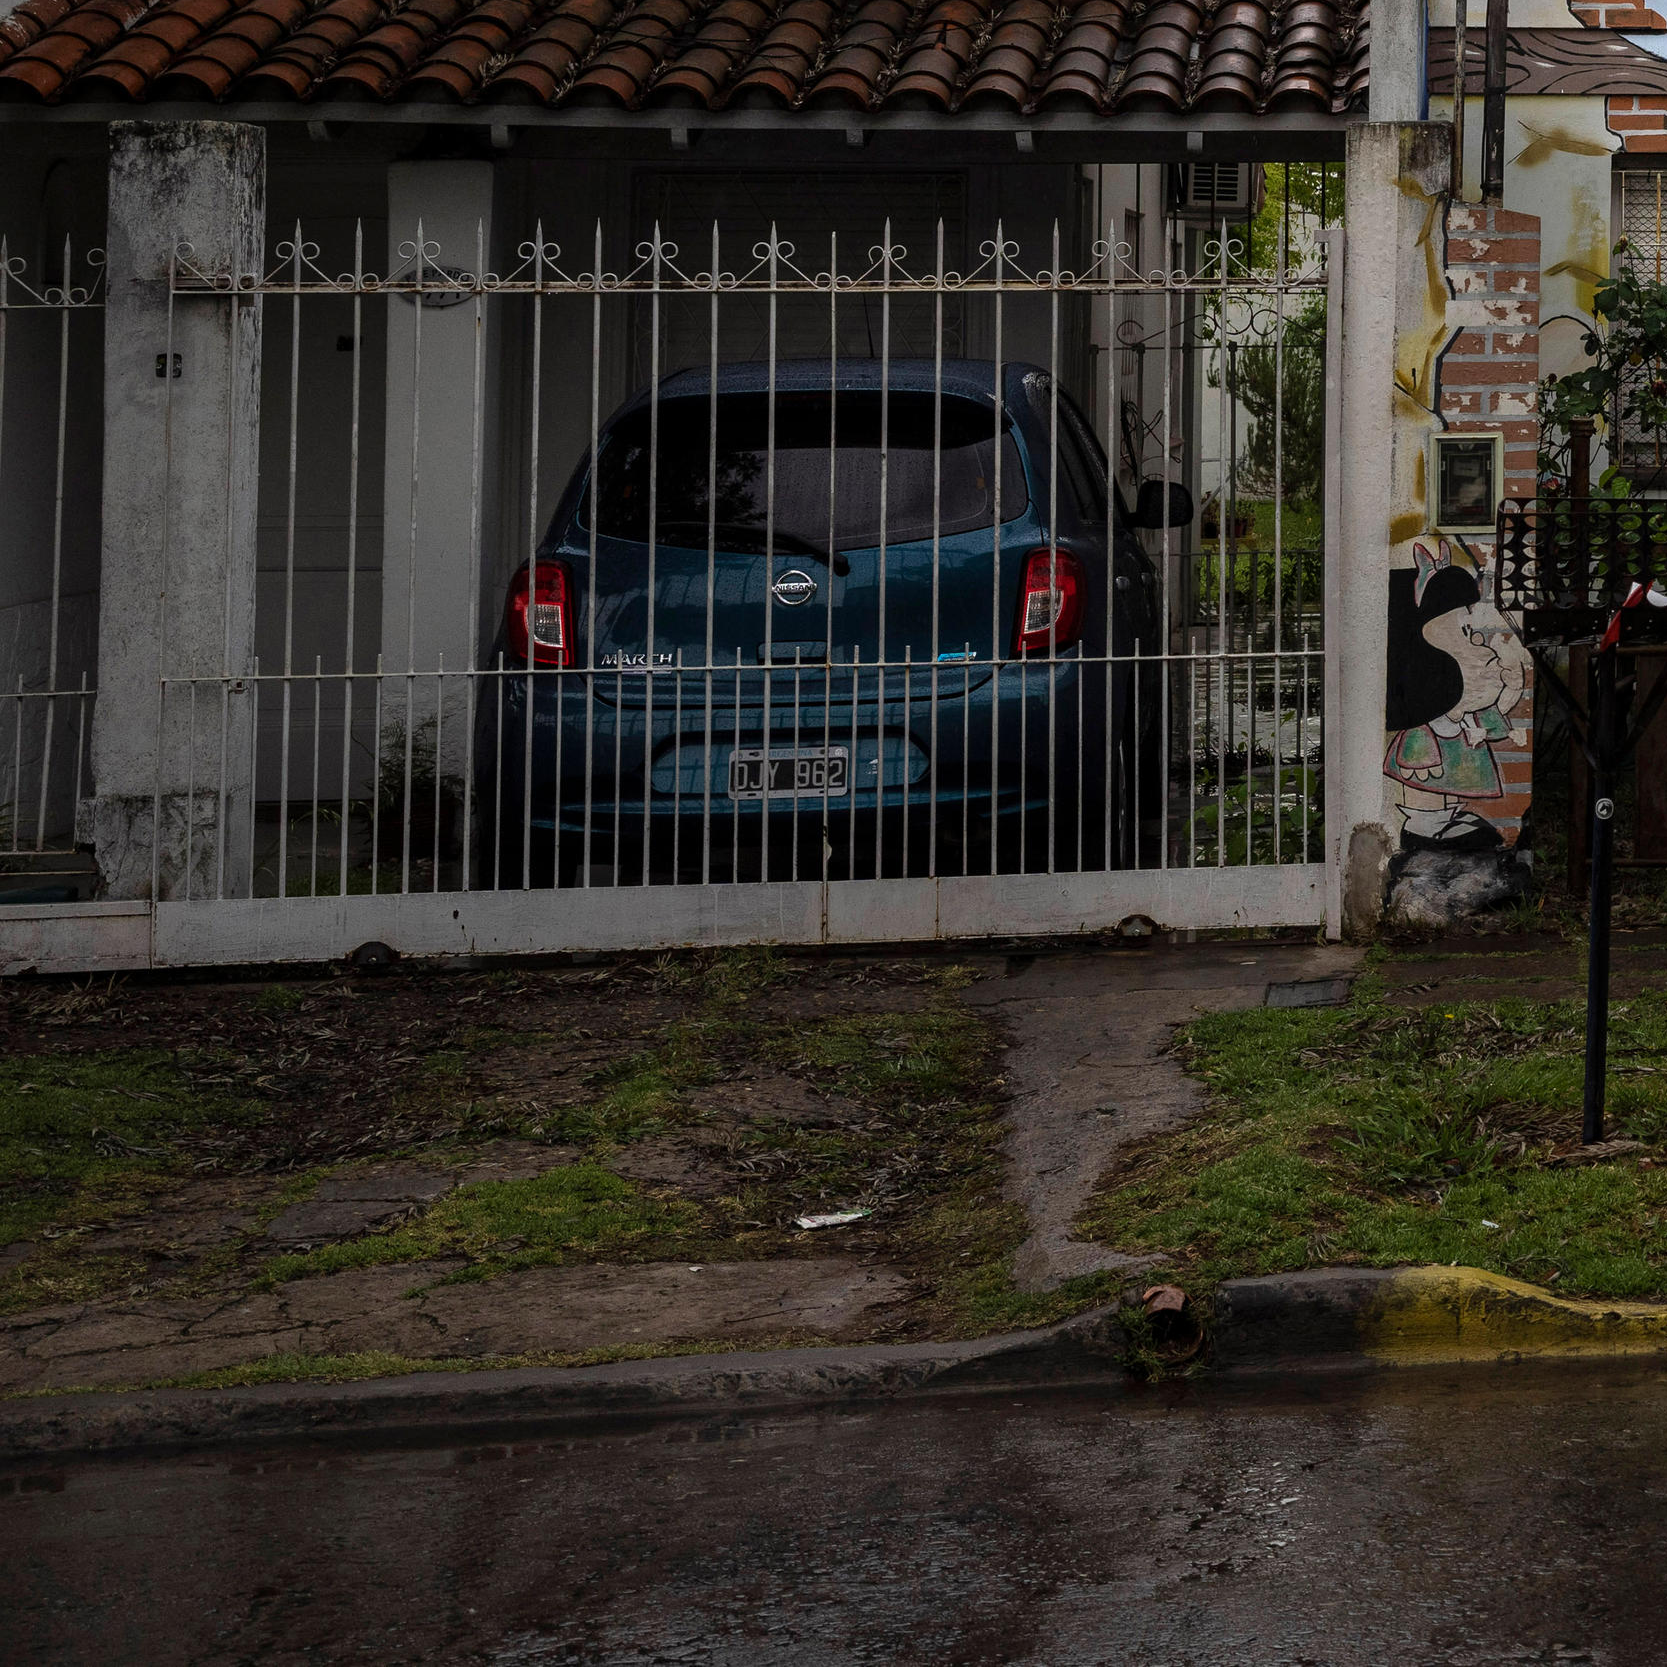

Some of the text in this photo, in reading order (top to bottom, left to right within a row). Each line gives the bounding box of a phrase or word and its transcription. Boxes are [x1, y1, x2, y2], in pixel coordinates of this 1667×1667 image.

[775, 584, 813, 593] NISSAN
[601, 653, 673, 665] MARCH
[764, 748, 813, 759] RGENINA
[796, 759, 843, 788] 962
